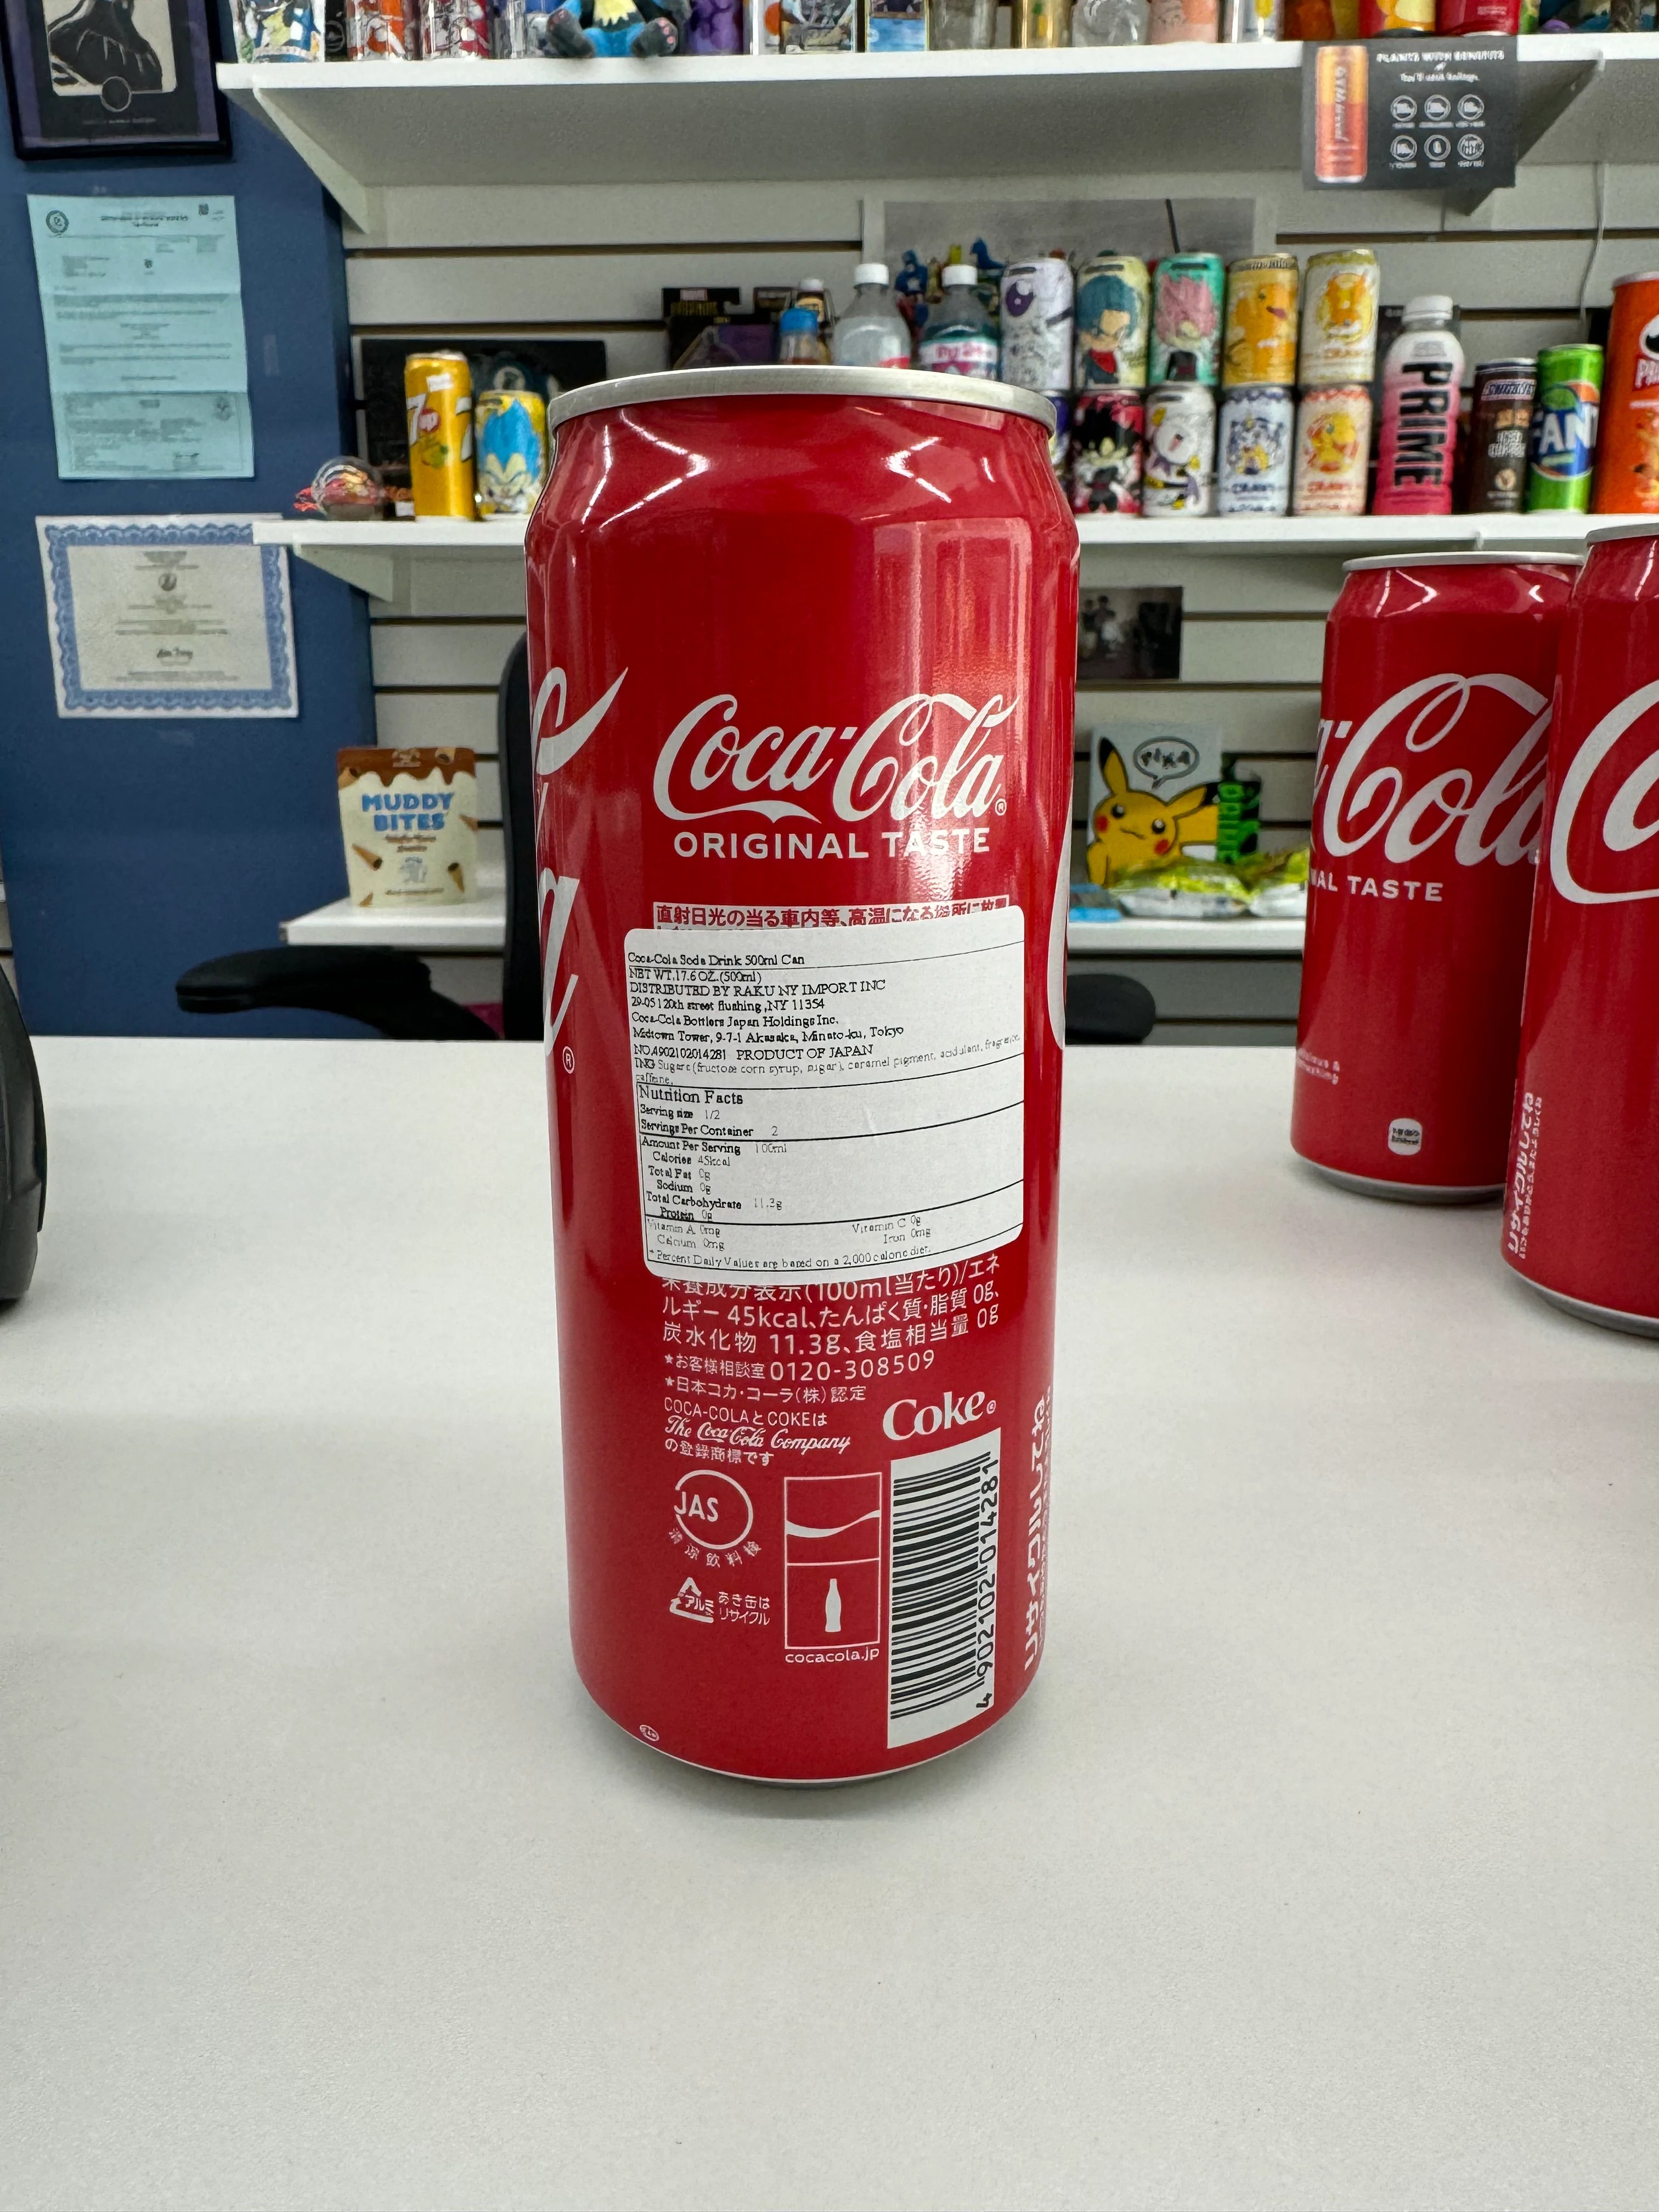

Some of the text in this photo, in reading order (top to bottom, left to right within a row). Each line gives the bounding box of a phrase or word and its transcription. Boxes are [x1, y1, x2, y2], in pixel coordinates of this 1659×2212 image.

[1394, 362, 1453, 486] PRIME
[653, 693, 1020, 824] Coca-Cola
[362, 792, 454, 812] MUDDY
[674, 827, 990, 859] ORIGINAL TASTE
[1347, 875, 1444, 902] TASTE
[628, 952, 805, 966] Coca-Cola Soda Drink 500ml Can
[629, 967, 651, 979] NET
[630, 979, 886, 997] DISTRIBUTED BY RAKU NY IMPORT INC
[631, 997, 656, 1008] 29-05
[718, 1001, 761, 1013] flushing
[793, 997, 825, 1011] 11354
[684, 1014, 724, 1027] Bottlers
[727, 1016, 759, 1030] Japan
[763, 1015, 815, 1028] Holdings
[678, 1031, 713, 1044] Tower,
[716, 1032, 741, 1043] 9-7-1
[870, 1026, 904, 1039] Tokyo
[736, 1048, 804, 1060] PRODUCT
[806, 1047, 825, 1059] OF
[828, 1044, 873, 1059] JAPAN
[741, 1065, 765, 1074] corn
[848, 1057, 890, 1070] caramel
[639, 1085, 743, 1105] Nutrition Facts
[640, 1104, 674, 1120] Serving
[705, 1109, 720, 1120] 1/2
[681, 1123, 698, 1135] Per
[701, 1125, 754, 1137] Container
[771, 1126, 778, 1137] 2
[641, 1136, 787, 1156] Amount Per Serving 100ml
[653, 1151, 692, 1165] Calories
[648, 1165, 673, 1177] Total
[657, 1180, 693, 1193] Sodium
[646, 1191, 670, 1204] Total
[672, 1194, 742, 1210] Carbohydrate
[660, 1206, 695, 1221] Protein
[648, 1219, 684, 1234] Vitamin
[686, 1225, 696, 1235] A
[852, 1221, 894, 1234] Vitamin
[897, 1218, 906, 1228] C
[883, 1233, 906, 1244] Iron
[693, 1254, 722, 1267] Daily
[724, 1257, 759, 1268] Values
[763, 1260, 778, 1269] are
[782, 1257, 812, 1268] based
[816, 1259, 830, 1268] on
[842, 1252, 872, 1266] 2,000
[883, 1391, 985, 1441] Coke
[664, 1415, 851, 1455] The Coca-Cola Company
[674, 1491, 719, 1522] JAS
[719, 1609, 771, 1626] リサイクル
[785, 1647, 879, 1663] cocacola.jp
